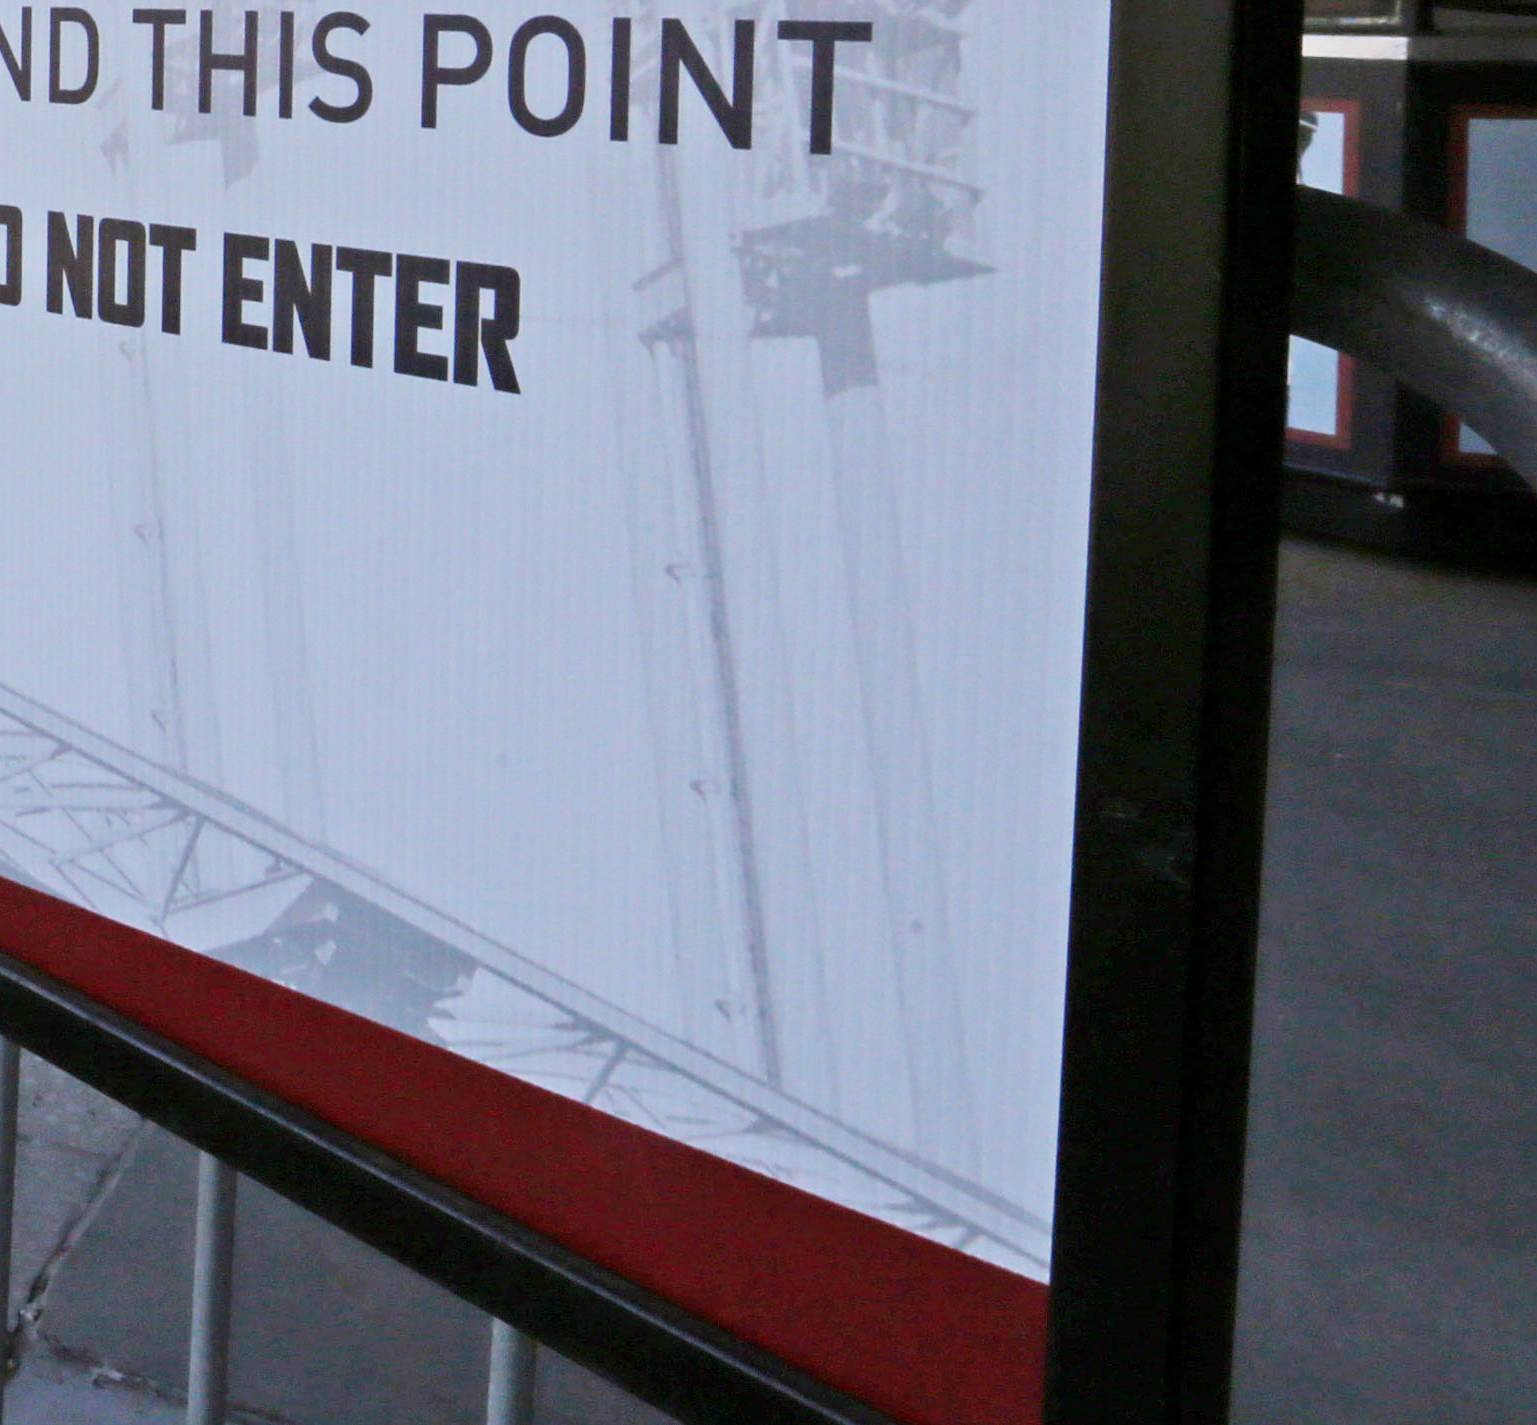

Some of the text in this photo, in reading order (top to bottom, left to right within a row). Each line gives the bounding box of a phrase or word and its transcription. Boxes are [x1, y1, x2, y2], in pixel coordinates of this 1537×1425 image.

[131, 8, 374, 125] THIS
[420, 13, 874, 156] POINT
[46, 210, 197, 336] NOT
[221, 232, 522, 395] ENTER
